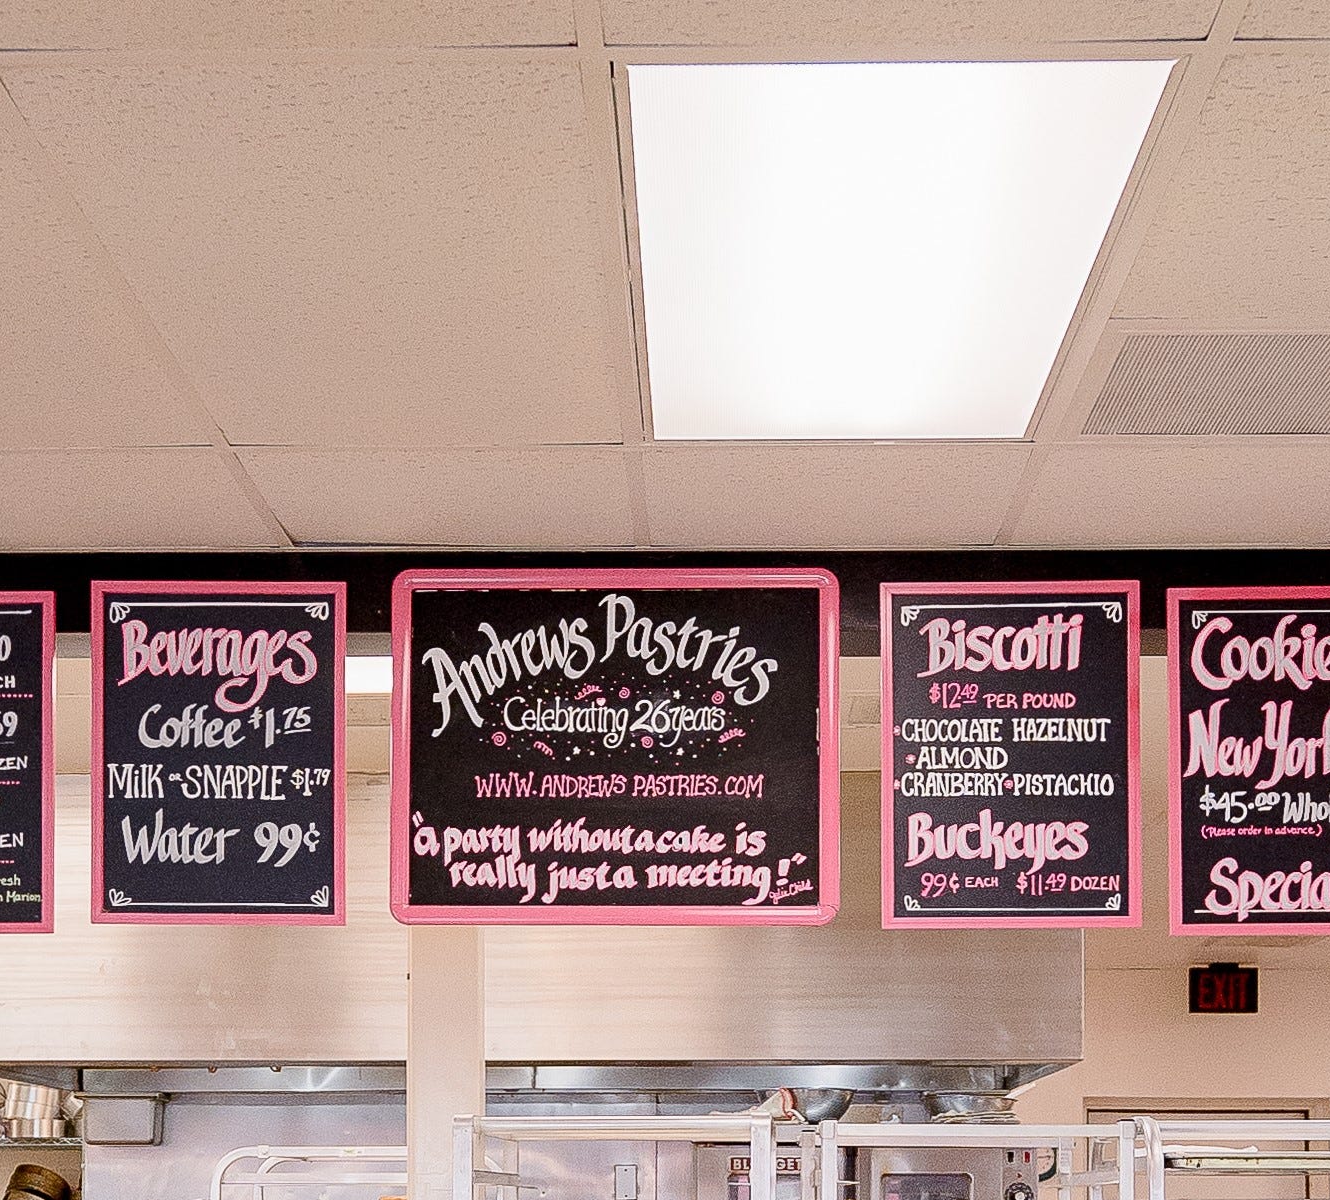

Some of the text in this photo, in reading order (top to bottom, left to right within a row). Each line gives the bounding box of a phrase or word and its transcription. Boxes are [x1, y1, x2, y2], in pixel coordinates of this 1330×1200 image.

[117, 619, 318, 713] Beverages
[422, 593, 778, 737] Andrews Pastries
[917, 613, 1084, 678] Biscotti
[929, 682, 1077, 710] $12.49 PER POUND
[138, 703, 311, 748] Coffee $1.75
[503, 696, 629, 749] Celebrating
[901, 718, 1111, 743] CHOCOLATE HAZELNUT
[1183, 699, 1262, 780] New
[915, 747, 1009, 770] ALMOND
[181, 764, 289, 801] SNAPPLE
[290, 767, 332, 797] $1.79
[900, 772, 1116, 797] CRANBERRY PISTACHIO
[1199, 784, 1280, 824] $45.00
[121, 808, 241, 865] Water
[443, 821, 521, 866] party
[527, 817, 633, 855] without
[655, 824, 727, 855] cake
[735, 822, 767, 856] is
[904, 808, 1090, 875] Buckeyes
[1238, 826, 1262, 836] order
[1264, 827, 1273, 836] in
[450, 856, 537, 903] really
[541, 860, 612, 904] just
[965, 875, 999, 889] EACH
[1070, 874, 1121, 891] DOZEN
[1198, 973, 1249, 1009] EXIT
